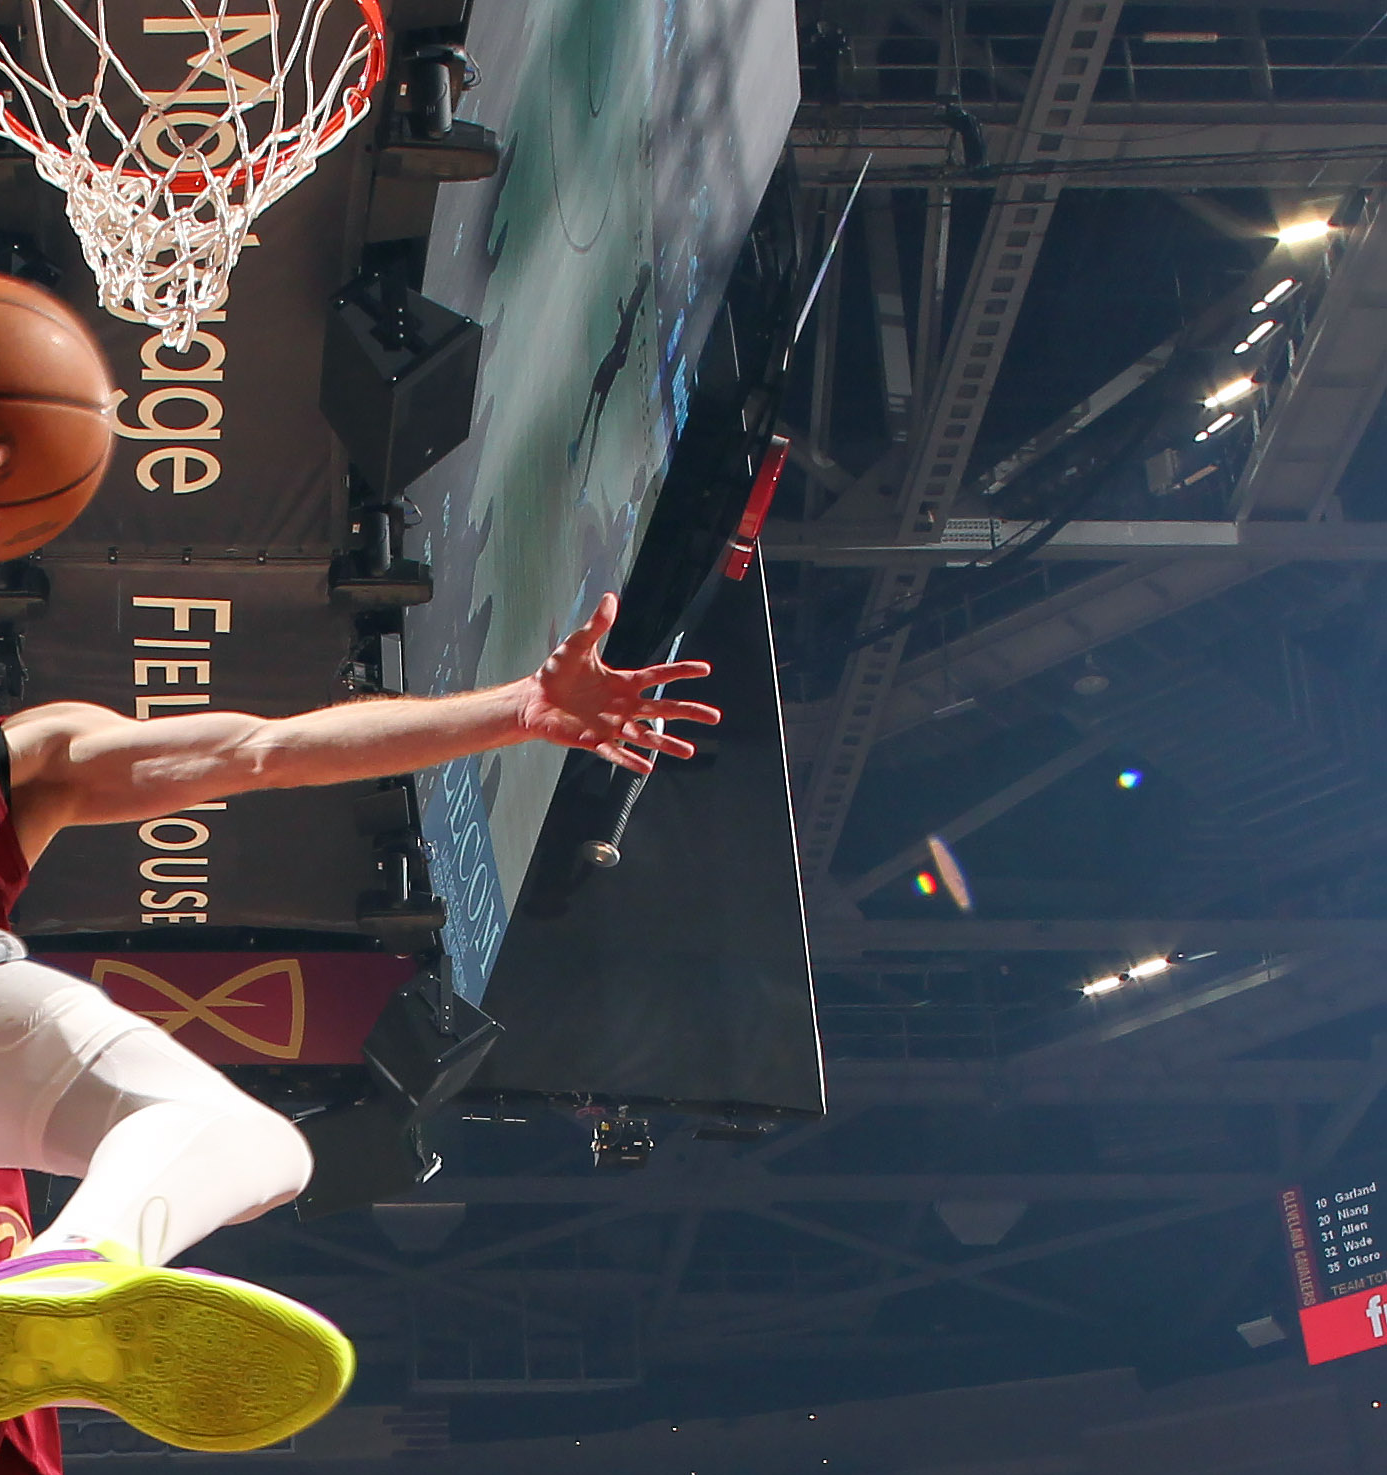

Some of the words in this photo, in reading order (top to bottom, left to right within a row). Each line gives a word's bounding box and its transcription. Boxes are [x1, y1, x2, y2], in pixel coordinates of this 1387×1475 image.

[133, 596, 232, 925] FIELOUSE
[1334, 1182, 1377, 1204] Garland
[1317, 1214, 1331, 1227] 20
[1337, 1203, 1369, 1221] Niang
[1321, 1230, 1334, 1242] 31
[1341, 1221, 1368, 1237] Allen
[1324, 1246, 1338, 1259] 32
[1343, 1237, 1373, 1253] Wade
[1347, 1251, 1381, 1268] Okoro
[1330, 1278, 1366, 1297] TEAM
